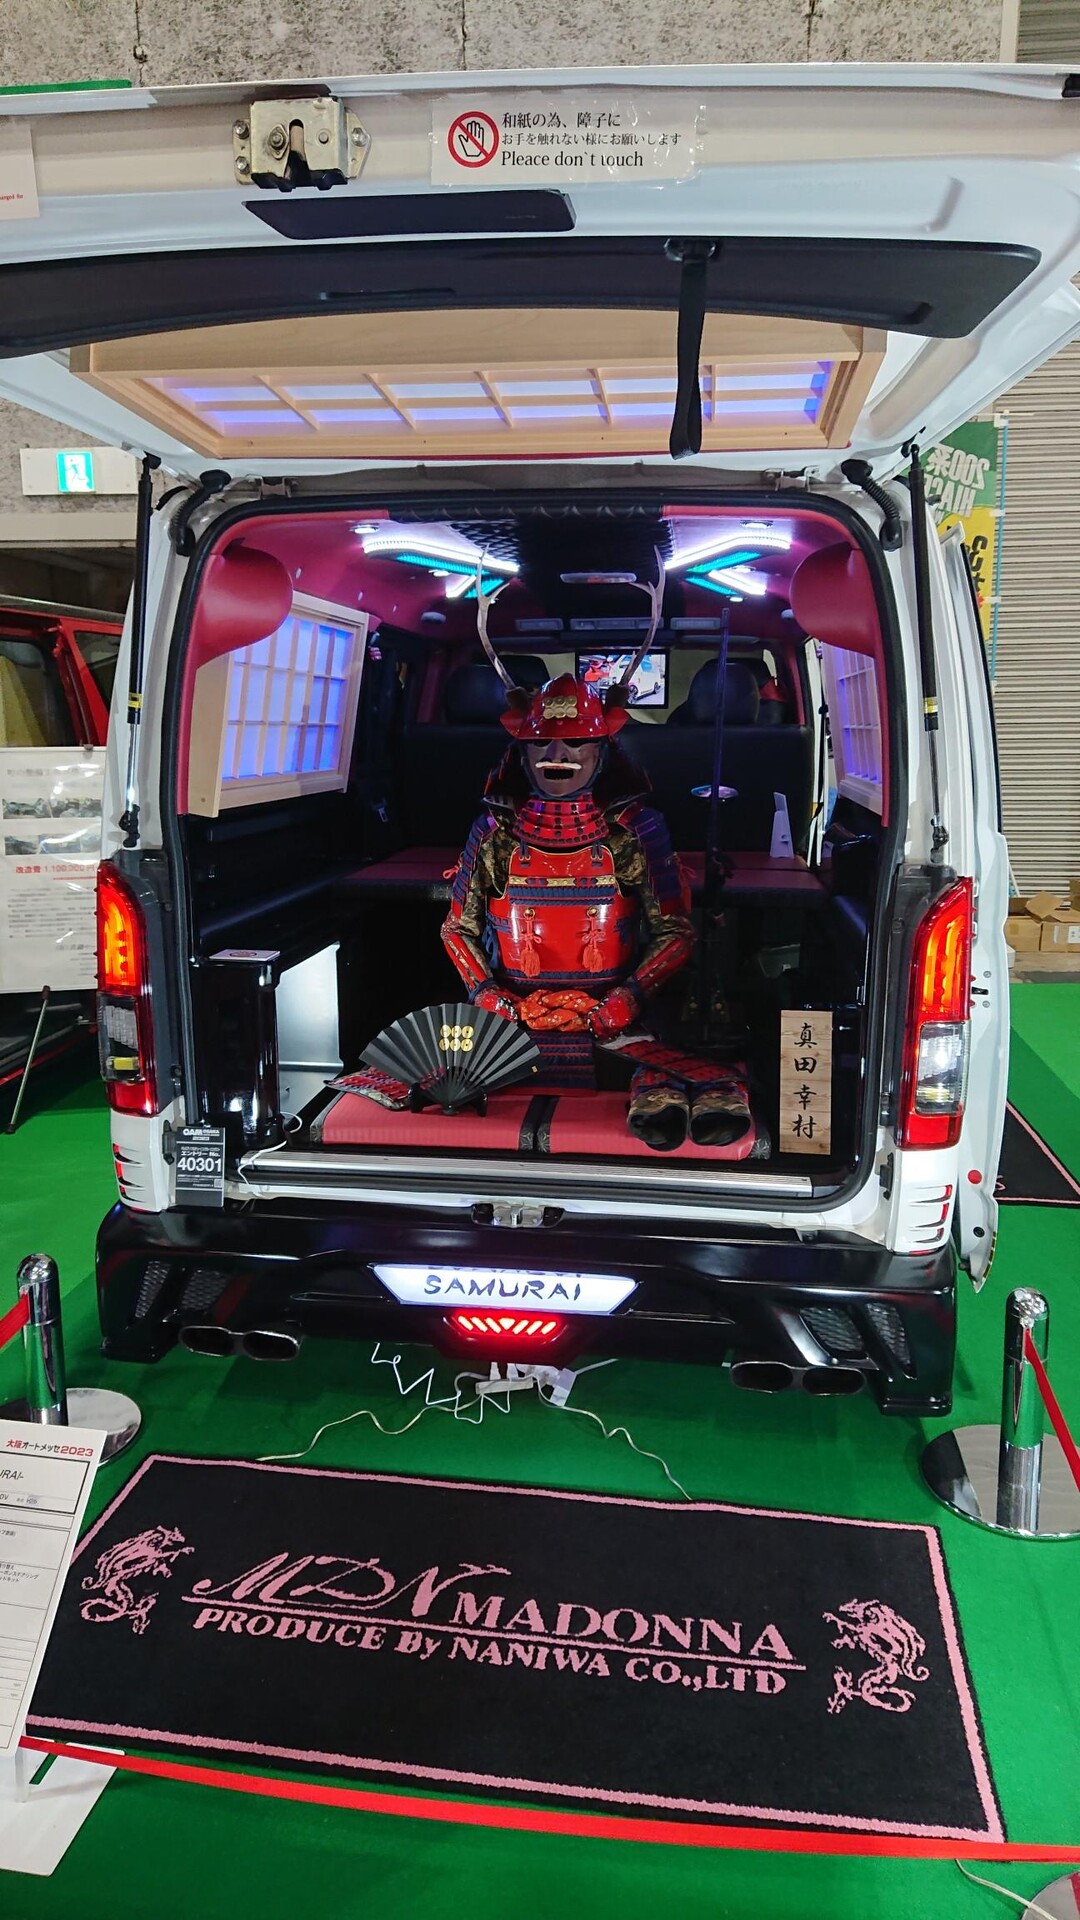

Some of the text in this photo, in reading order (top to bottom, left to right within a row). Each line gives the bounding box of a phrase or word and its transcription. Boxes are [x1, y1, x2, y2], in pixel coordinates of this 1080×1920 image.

[502, 112, 621, 129] 和紙の為、障子に
[502, 132, 682, 147] お手を触れない様にお願いします
[501, 151, 550, 167] Pleace
[792, 1022, 818, 1139] 真田幸村
[177, 1157, 222, 1172] 40301
[424, 1274, 581, 1301] SAMURAI
[449, 1591, 797, 1660] MADONNA
[193, 1607, 387, 1650] PRODUCE
[448, 1637, 610, 1676] NANIWA
